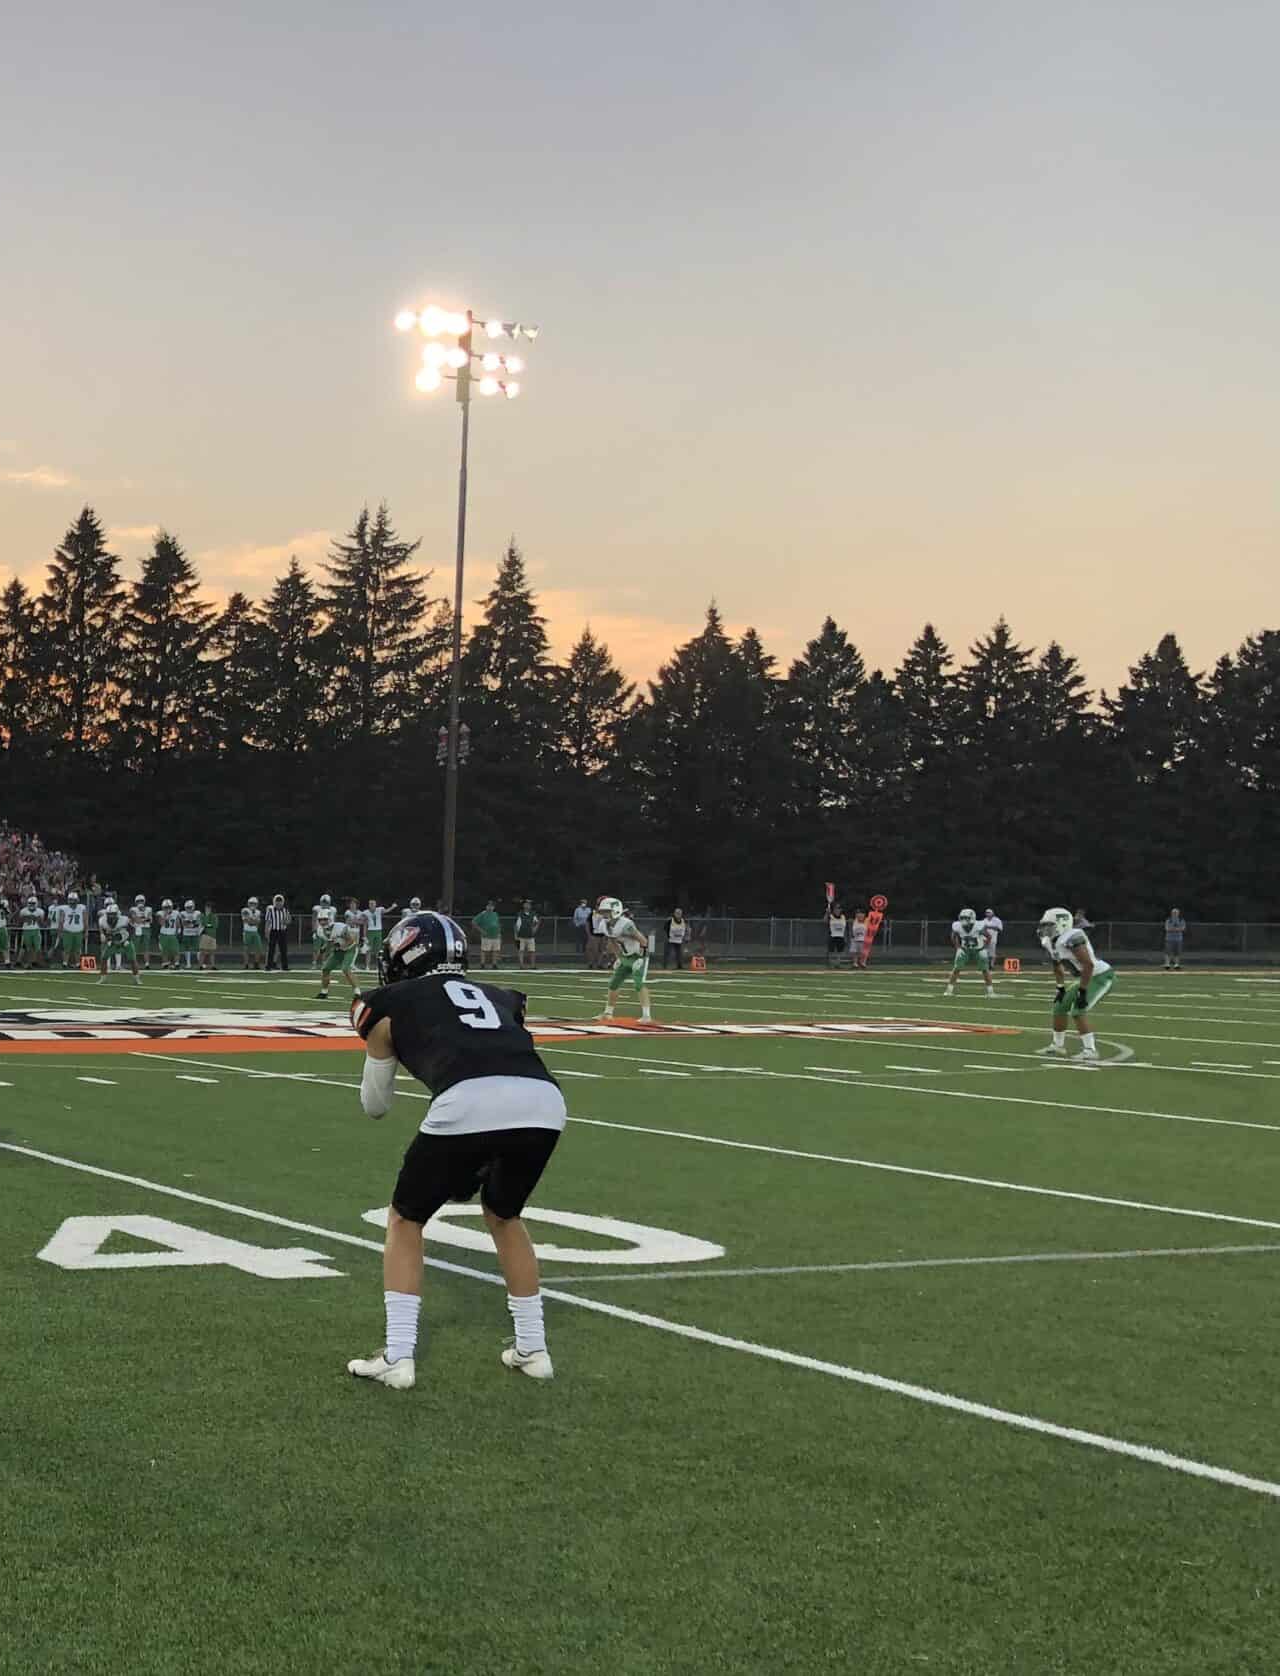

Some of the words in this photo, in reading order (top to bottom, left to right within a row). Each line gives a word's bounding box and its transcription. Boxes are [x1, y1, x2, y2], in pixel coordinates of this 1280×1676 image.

[455, 940, 463, 957] 9
[83, 958, 95, 969] 40
[1007, 959, 1018, 970] 10
[443, 980, 502, 1029] 9
[36, 1203, 725, 1278] 40
